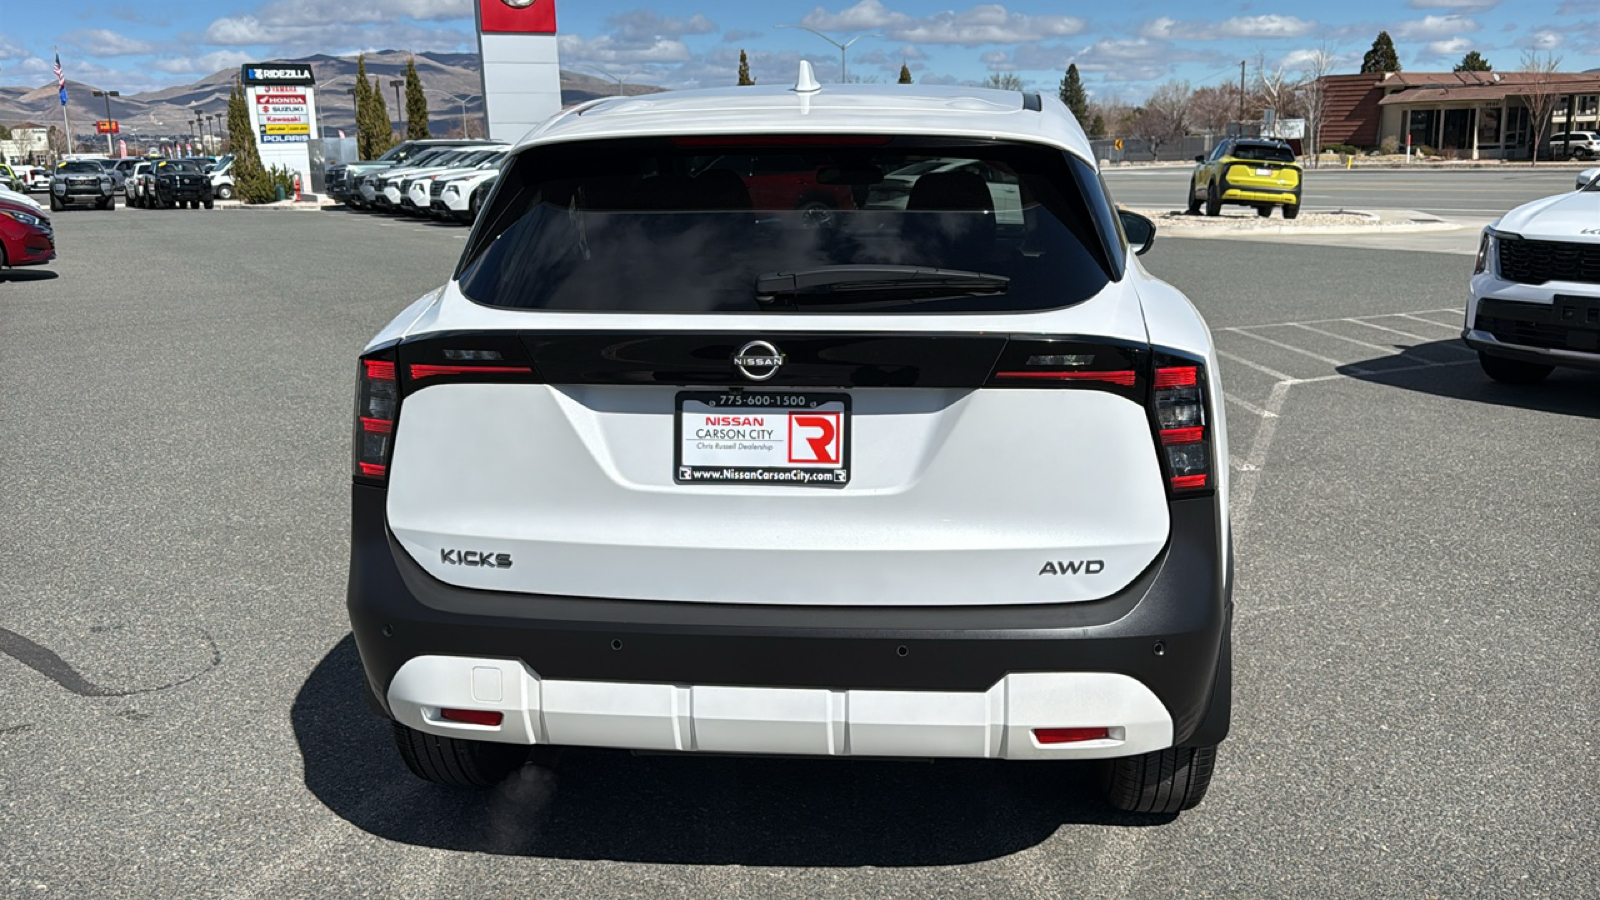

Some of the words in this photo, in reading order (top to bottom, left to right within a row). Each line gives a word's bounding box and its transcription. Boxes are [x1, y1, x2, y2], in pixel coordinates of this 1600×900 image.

[263, 69, 311, 79] RIDEZILLA
[734, 358, 782, 366] NISSAN
[720, 395, 806, 406] 775-600-1500
[705, 416, 765, 427] NISSAN
[695, 428, 746, 440] CARSON
[748, 429, 774, 440] CITY
[794, 416, 835, 461] R
[696, 442, 713, 450] Chris
[714, 442, 737, 450] Russell
[738, 443, 774, 452] Dealership
[693, 468, 833, 482] www.NissanCarsonCity.com
[440, 548, 513, 569] KICKS
[1038, 559, 1105, 576] AWD
